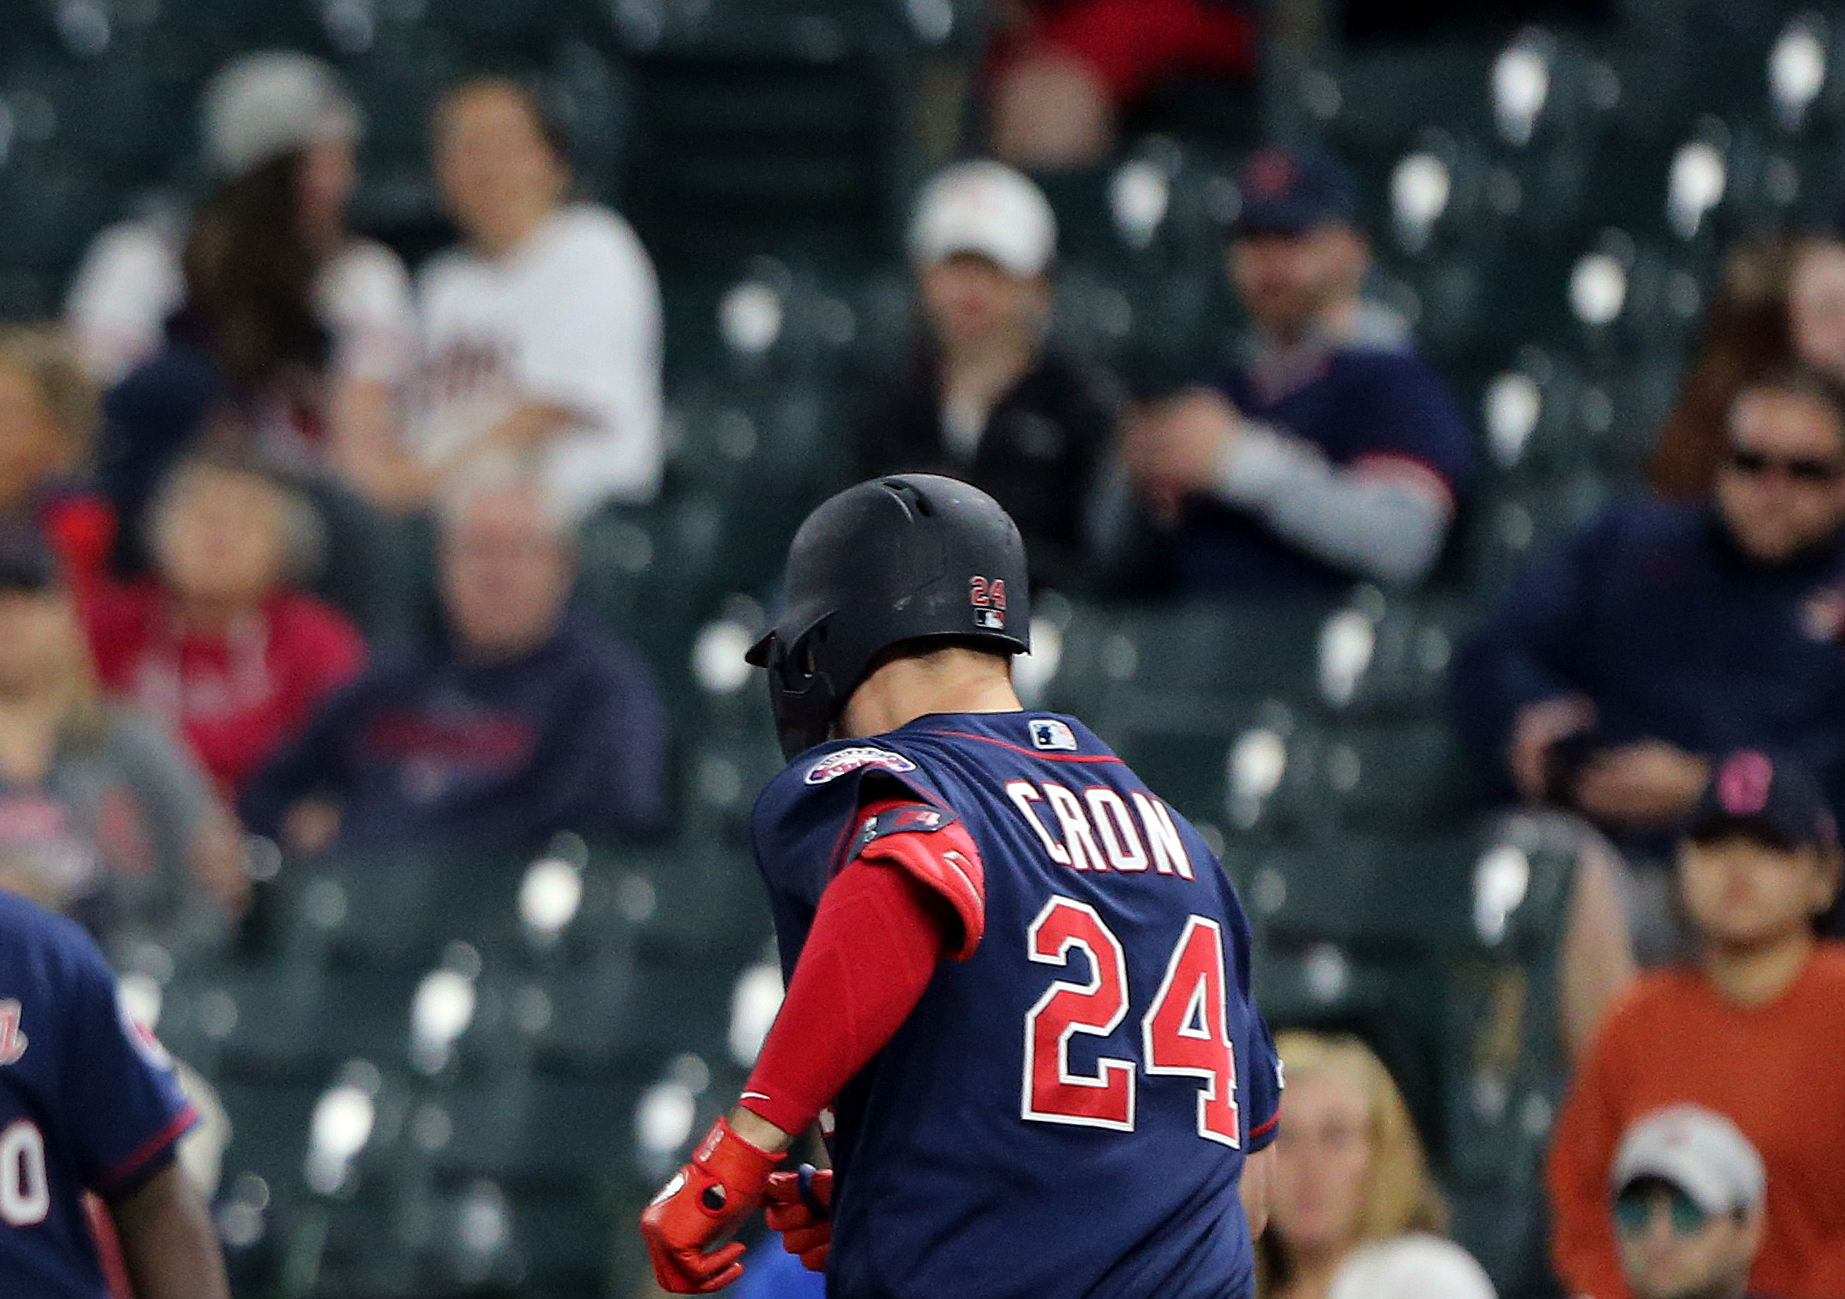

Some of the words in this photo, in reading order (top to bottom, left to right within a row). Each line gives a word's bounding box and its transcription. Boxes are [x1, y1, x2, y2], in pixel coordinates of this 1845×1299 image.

[969, 576, 1006, 609] 24
[1004, 778, 1196, 881] CRON
[1020, 893, 1241, 1149] 24
